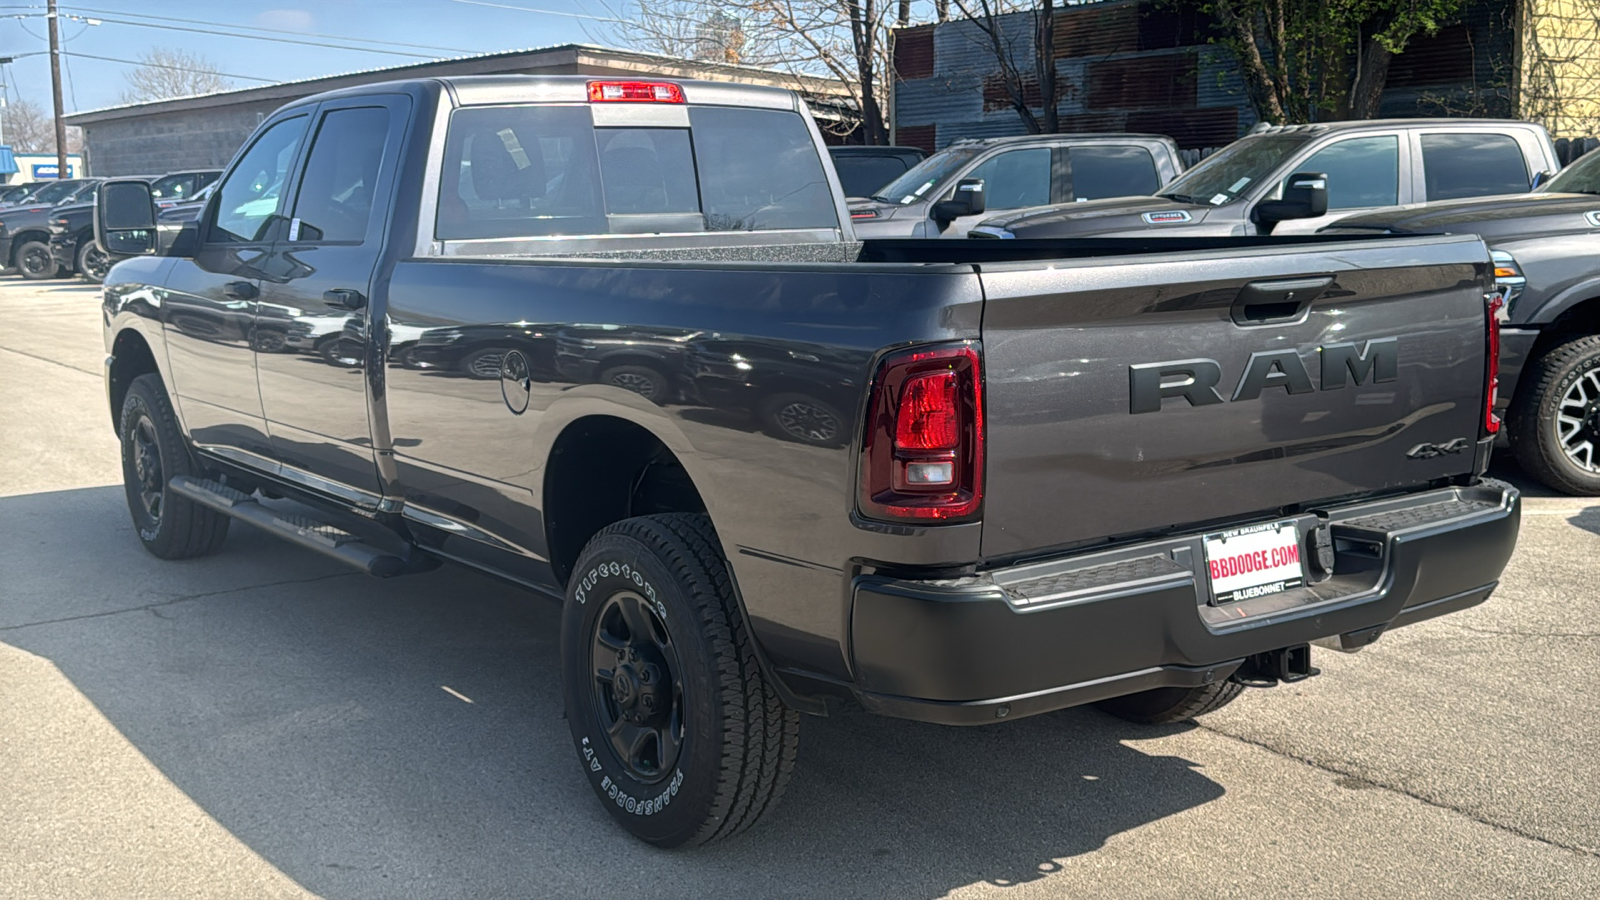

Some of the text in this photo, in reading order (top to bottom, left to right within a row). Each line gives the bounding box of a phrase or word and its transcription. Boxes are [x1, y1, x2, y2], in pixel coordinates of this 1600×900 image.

[1129, 336, 1398, 414] RAM
[1223, 523, 1279, 538] NEW BRAUNFELS
[1209, 544, 1300, 580] BBDODGE.COM
[575, 562, 667, 619] Firestone
[1232, 582, 1286, 601] BLUEBONNET
[601, 768, 684, 815] TRANSFORCE
